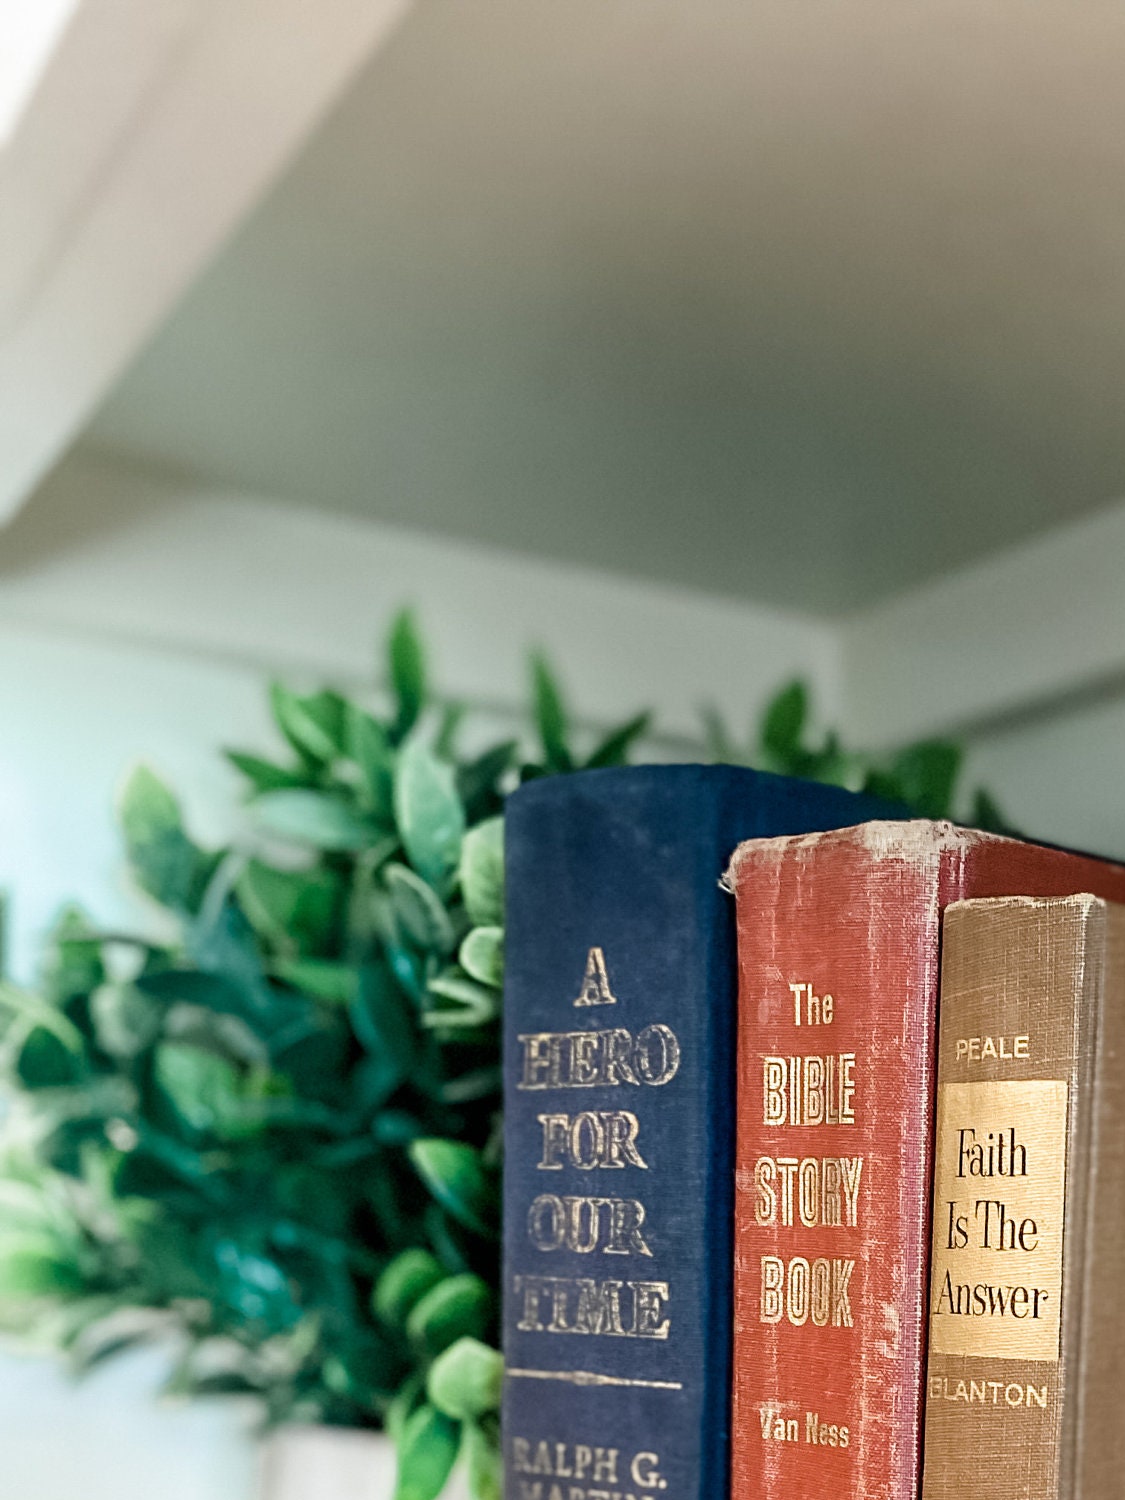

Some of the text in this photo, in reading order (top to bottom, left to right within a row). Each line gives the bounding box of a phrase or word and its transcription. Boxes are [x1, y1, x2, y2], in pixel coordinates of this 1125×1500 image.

[574, 946, 616, 1007] A
[789, 983, 833, 1026] The
[517, 1024, 680, 1086] HERO
[956, 1035, 1030, 1060] PEALE
[762, 1053, 855, 1126] BIBLE
[536, 1110, 648, 1170] FOR
[956, 1128, 1027, 1179] Faith
[754, 1157, 862, 1228] STORY
[526, 1194, 653, 1257] OUR
[946, 1200, 1039, 1252] Is The
[513, 1275, 669, 1339] TIME
[760, 1256, 854, 1327] BOOK
[933, 1270, 1049, 1319] Answer
[929, 1376, 1048, 1408] BLANTON
[759, 1410, 850, 1448] Van Ness
[512, 1436, 668, 1489] RALPH G.
